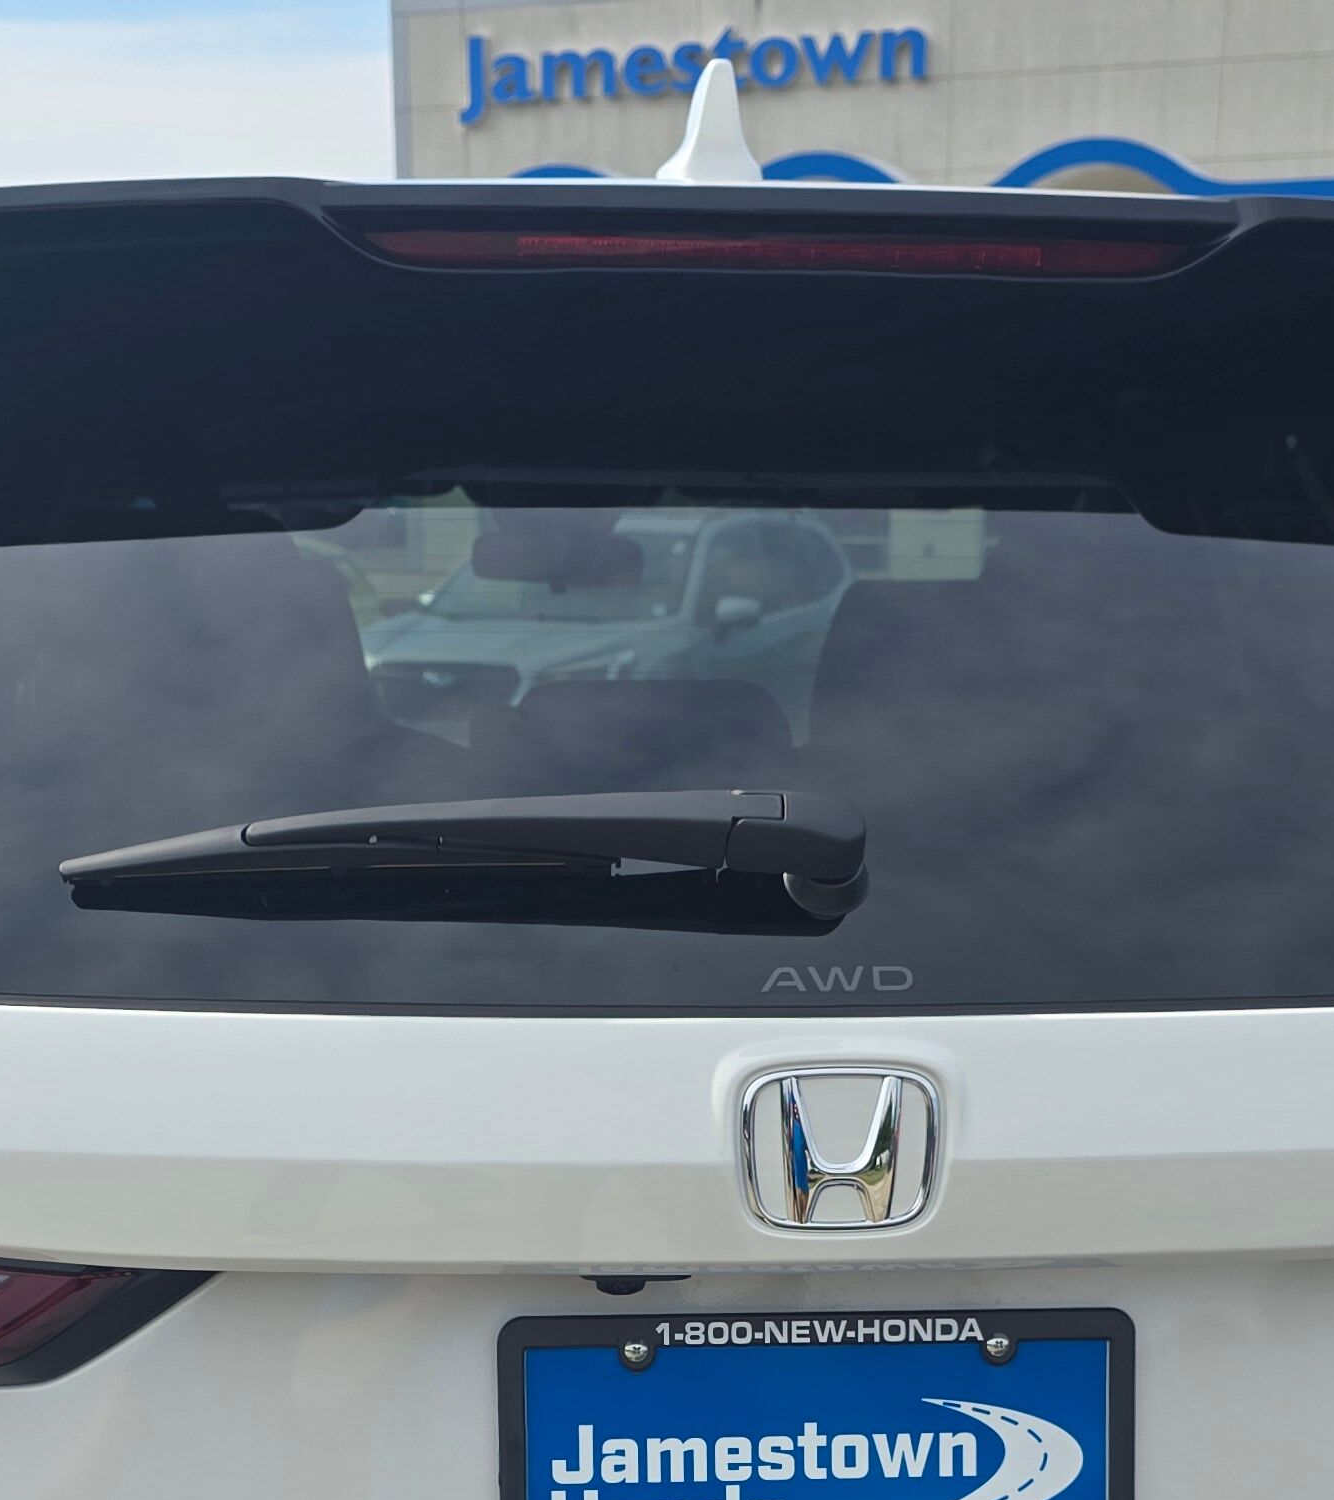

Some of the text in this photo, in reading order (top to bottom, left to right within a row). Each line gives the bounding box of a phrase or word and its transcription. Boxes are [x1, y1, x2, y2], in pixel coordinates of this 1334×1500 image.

[460, 26, 928, 125] Jamestown
[761, 966, 913, 992] AWD
[656, 1318, 984, 1346] 1-800-NEW-HONDA
[552, 1421, 978, 1485] Jamestown
